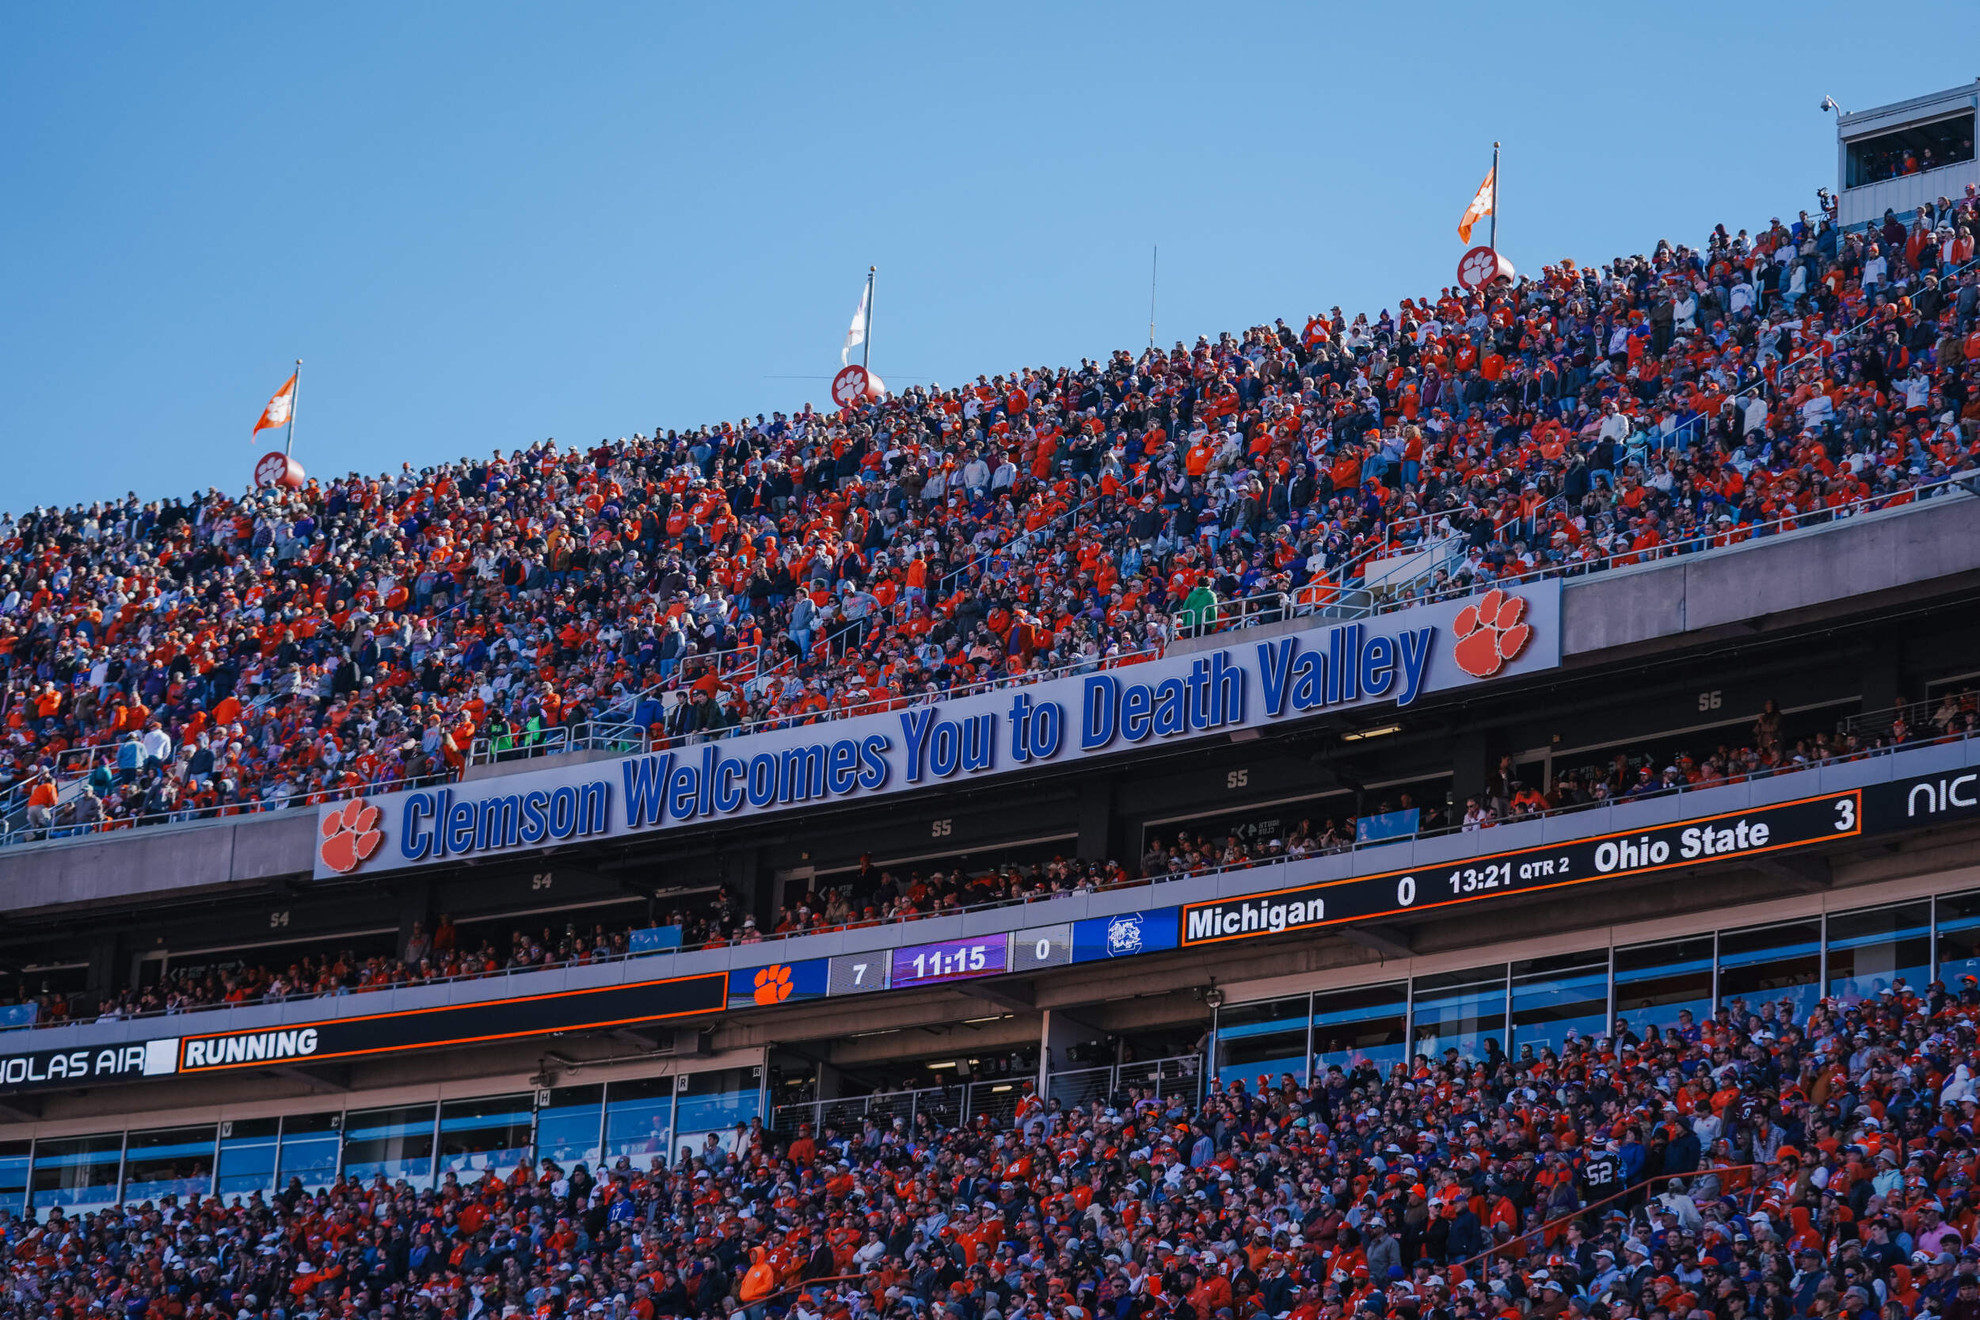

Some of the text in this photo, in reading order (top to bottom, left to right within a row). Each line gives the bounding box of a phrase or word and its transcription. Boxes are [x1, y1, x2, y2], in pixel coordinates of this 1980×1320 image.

[1698, 690, 1722, 711] S6
[401, 623, 1437, 862] Clemson Welcomes You to Death Valley
[1227, 769, 1249, 789] S5
[931, 818, 952, 837] S5
[1834, 799, 1855, 831] 3
[1595, 818, 1770, 872] Ohio State
[532, 871, 553, 890] S4
[1449, 857, 1570, 894] 13:21 QTR 2
[1396, 875, 1416, 907] 0
[269, 910, 290, 928] S4
[1188, 897, 1325, 940] Michigan
[913, 945, 986, 978] 11:15
[1035, 938, 1050, 960] 0
[852, 963, 867, 985] 7
[186, 1028, 318, 1067] RUNNING
[0, 1046, 144, 1084] OLAS AIR
[1585, 1162, 1614, 1186] 52
[610, 1207, 623, 1221] 17
